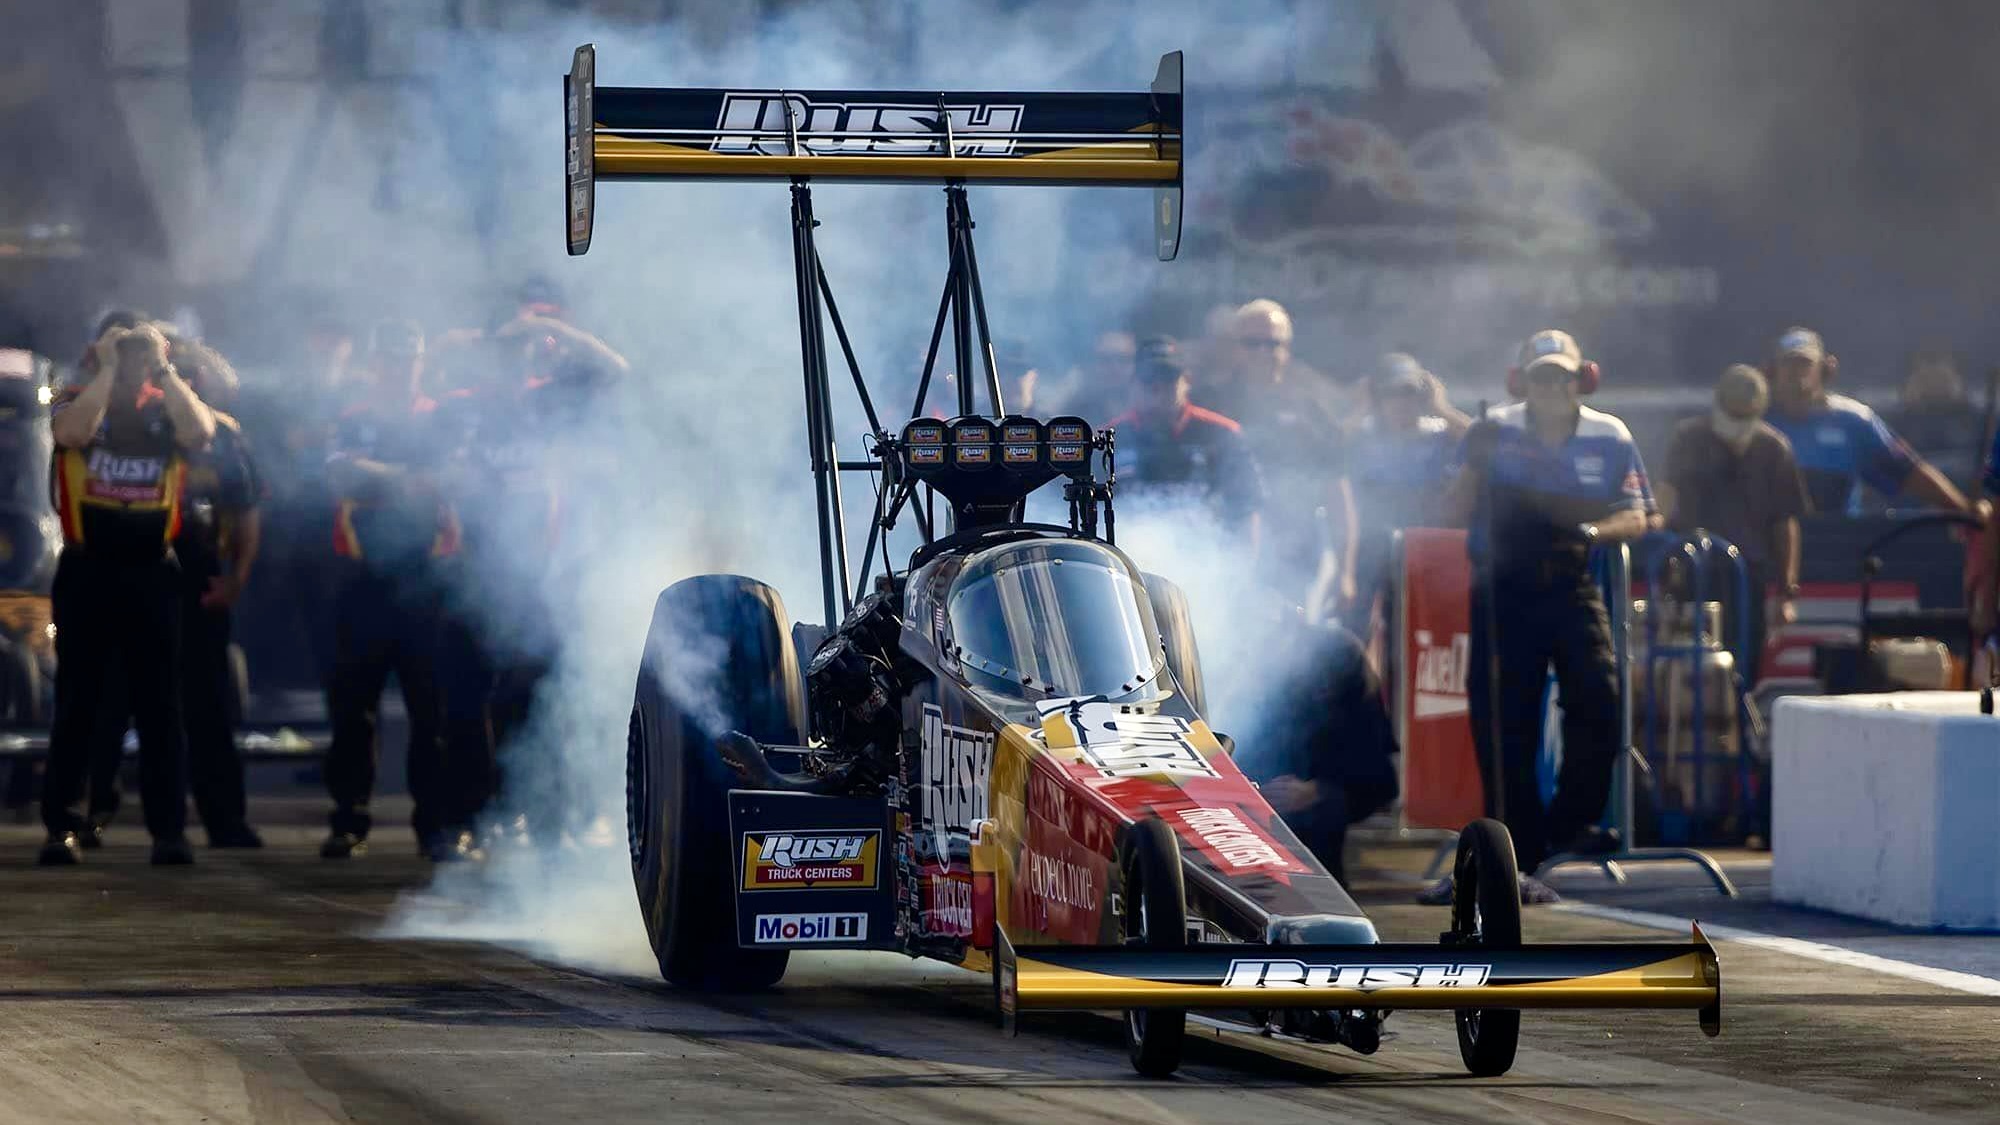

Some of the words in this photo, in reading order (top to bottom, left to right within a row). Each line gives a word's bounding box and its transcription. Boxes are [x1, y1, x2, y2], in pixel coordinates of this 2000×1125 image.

[708, 92, 1024, 157] RUSH
[921, 702, 994, 874] RUSH
[757, 834, 865, 868] RUSH
[767, 868, 802, 880] TRUCK
[804, 867, 853, 879] CENTERS
[1031, 852, 1067, 919] expect
[759, 917, 830, 939] Mobil
[1221, 958, 1492, 988] RUSH
